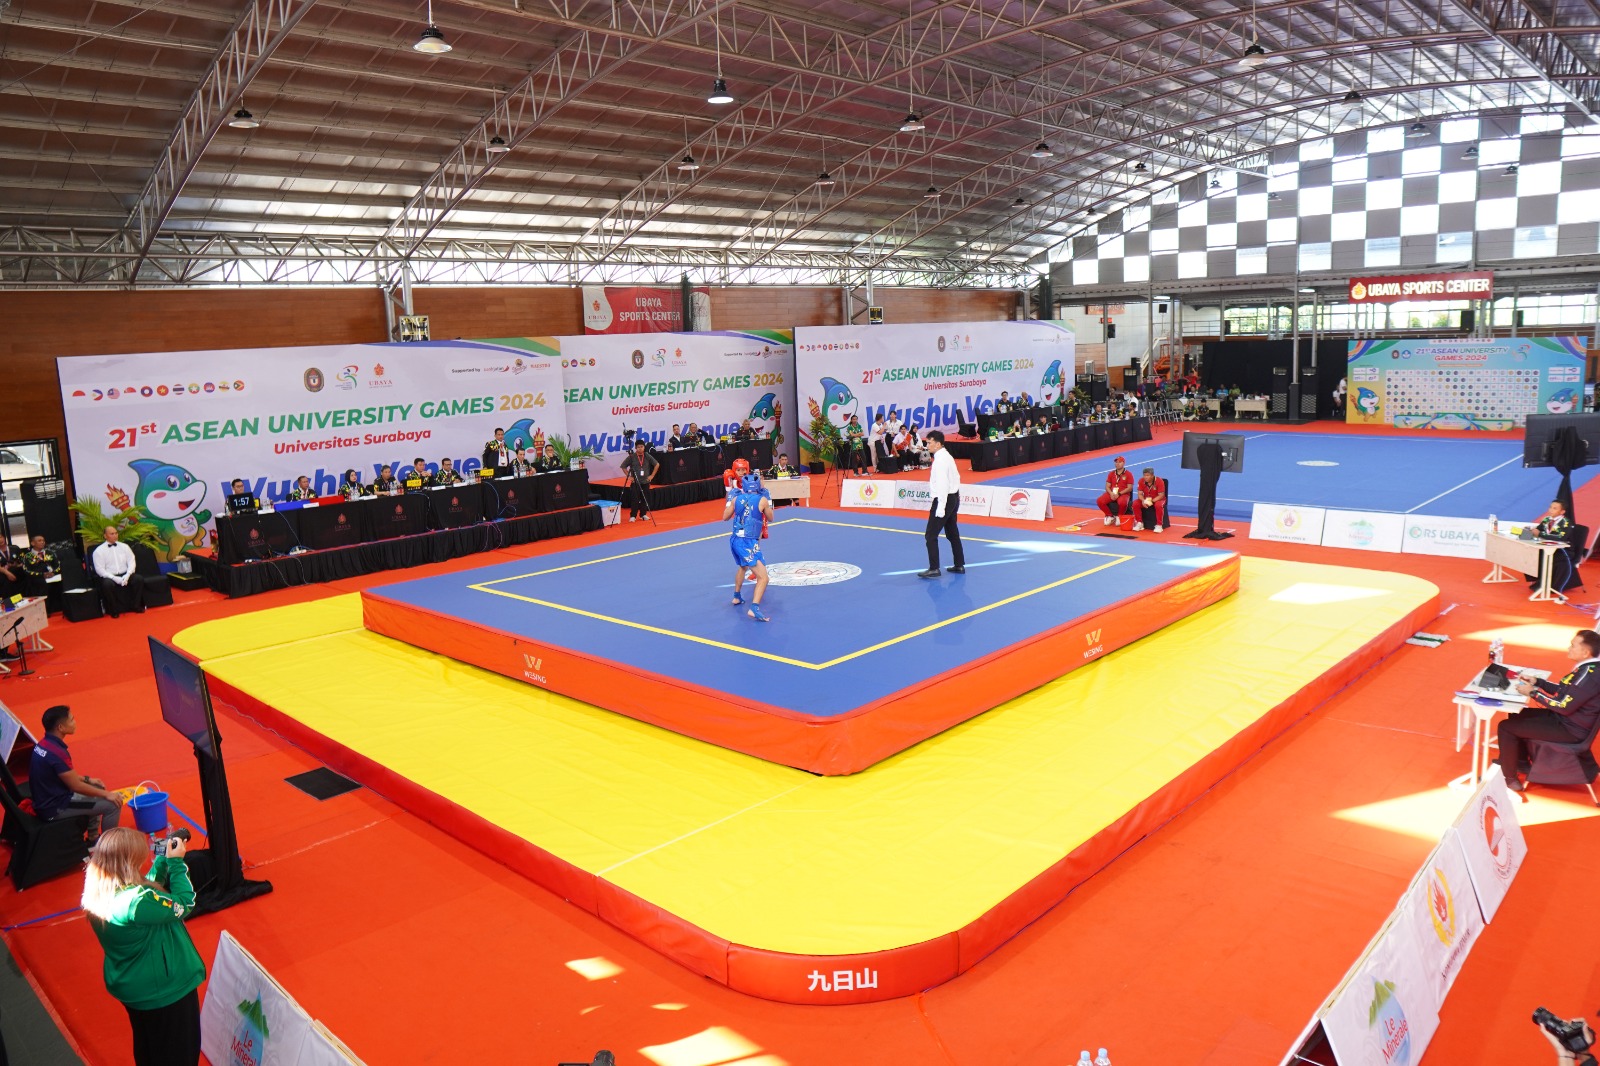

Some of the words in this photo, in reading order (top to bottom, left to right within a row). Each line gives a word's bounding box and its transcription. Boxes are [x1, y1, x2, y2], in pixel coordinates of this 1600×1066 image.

[1368, 282, 1401, 296] UBAYA
[1402, 280, 1445, 295] SPORTS
[1446, 278, 1490, 293] CENTER
[636, 297, 662, 307] UBAYA
[620, 311, 650, 322] SPORTS
[652, 311, 680, 321] CENTER
[862, 368, 881, 384] 21st
[882, 366, 919, 382] ASEAN
[922, 362, 979, 379] UNIVERSITY
[982, 359, 1013, 373] GAMES
[1014, 358, 1034, 370] 2024
[609, 379, 699, 400] UNIVERSITY
[702, 374, 751, 391] GAMES
[753, 372, 784, 387] 2024
[924, 380, 958, 391] Universitas
[958, 378, 987, 388] Surabaya
[612, 402, 665, 416] Universitas
[667, 399, 710, 411] Surabaya
[108, 421, 157, 450] 21st
[161, 417, 260, 445] ASEAN
[268, 403, 414, 434] UNIVERSITY
[419, 396, 495, 419] GAMES
[500, 392, 547, 411] 2024
[274, 436, 360, 455] Universitas
[364, 430, 432, 445] Surabaya
[233, 496, 250, 507] 1:57
[907, 490, 915, 498] RS
[1424, 528, 1437, 538] RS
[1440, 529, 1480, 542] UBAYA
[807, 967, 879, 992] 九日山
[1384, 1017, 1396, 1037] Le
[243, 1030, 253, 1052] Le
[1381, 1019, 1409, 1065] Minerale
